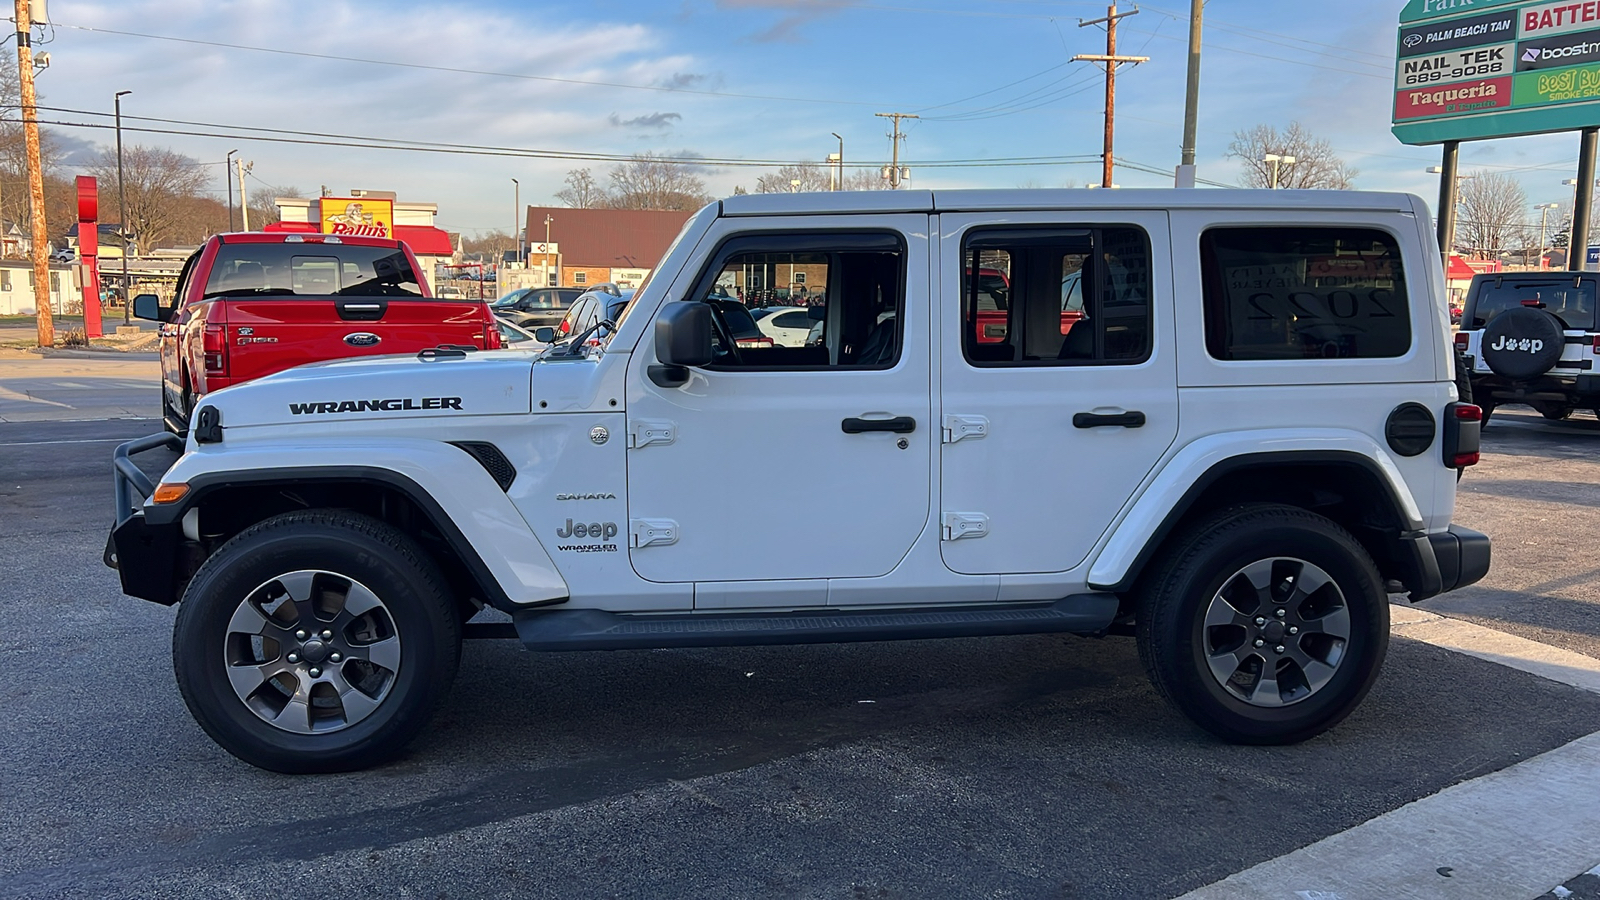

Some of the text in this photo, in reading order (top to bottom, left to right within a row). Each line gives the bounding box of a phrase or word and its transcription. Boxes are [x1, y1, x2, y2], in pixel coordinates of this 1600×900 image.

[1525, 1, 1600, 31] BATTE
[1425, 19, 1511, 43] PALM BEACH TAN
[1404, 47, 1505, 74] NAIL TEK
[1406, 62, 1503, 84] 689-9088
[1579, 68, 1600, 90] BU
[1549, 89, 1581, 101] SMOKE
[1491, 335, 1544, 354] Jp
[289, 397, 464, 415] WRANGLER
[556, 492, 616, 500] SAHARA
[556, 518, 618, 541] Jeep
